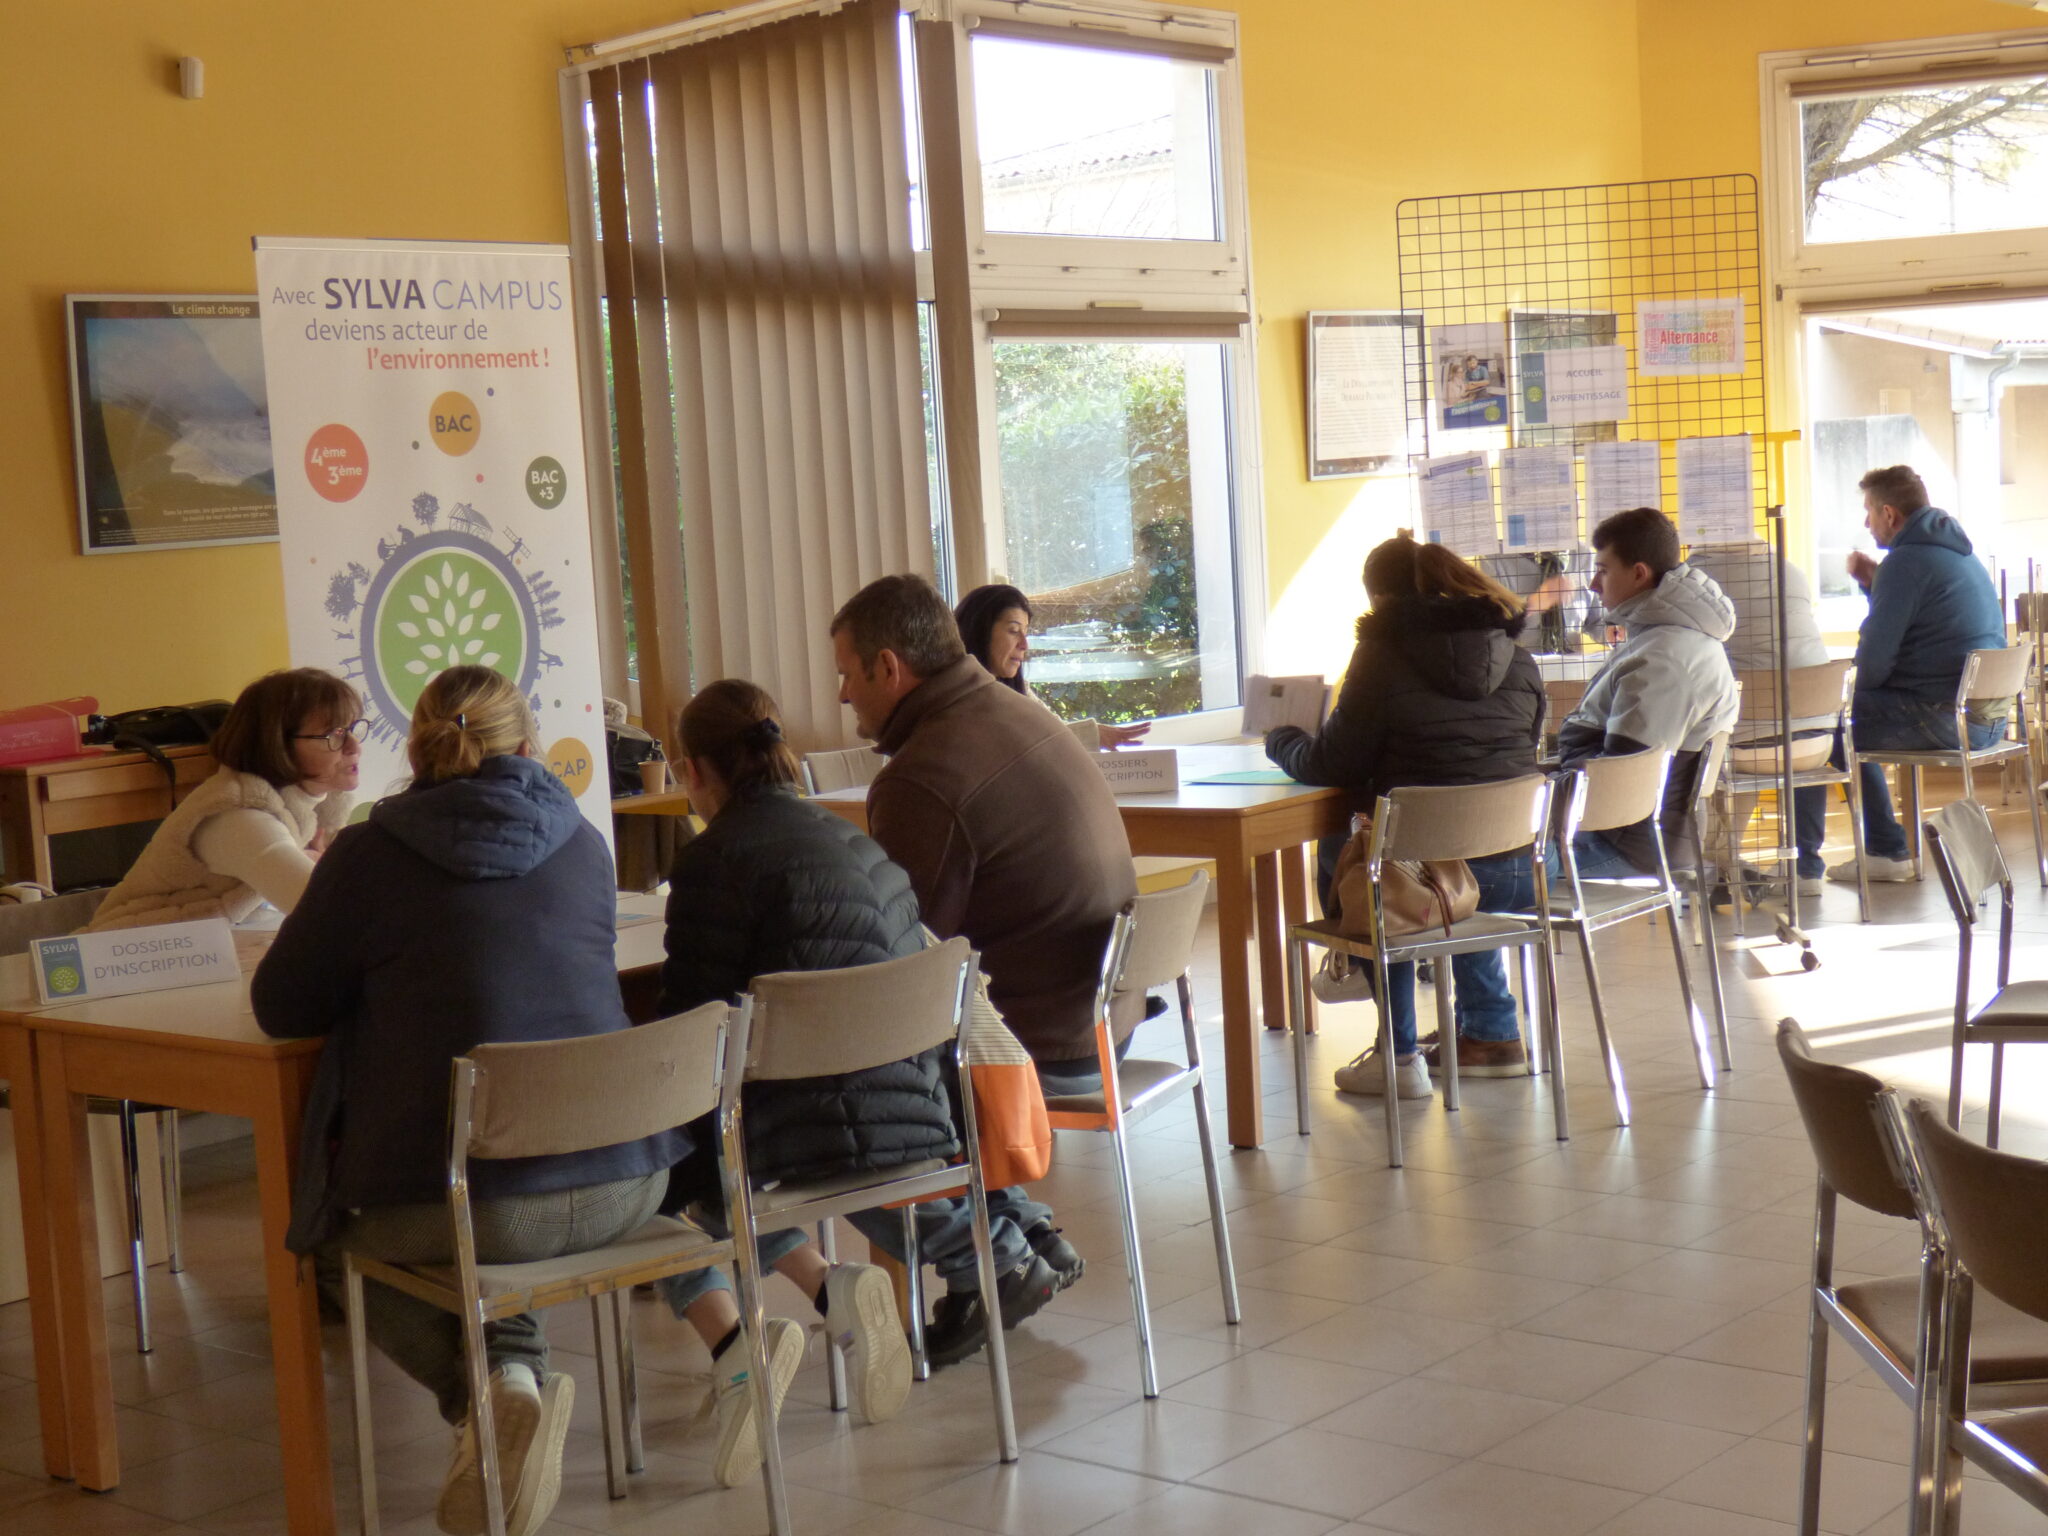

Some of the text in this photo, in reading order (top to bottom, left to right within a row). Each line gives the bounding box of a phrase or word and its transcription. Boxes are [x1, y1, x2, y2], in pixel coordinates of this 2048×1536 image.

[272, 277, 562, 311] Avec SYLVA CAMPUS
[172, 303, 184, 315] Le
[186, 303, 216, 315] climat
[305, 317, 488, 341] deviens acteur de
[1660, 330, 1719, 345] Alternance
[1522, 370, 1545, 379] SYLVA
[1566, 368, 1604, 379] ACCUEIL
[1550, 390, 1622, 403] APPRENTISSAGE
[435, 414, 473, 433] BAC
[311, 447, 347, 467] 4ème
[328, 464, 363, 485] 3ème
[531, 469, 560, 485] BAC
[539, 486, 555, 500] +3
[551, 758, 587, 778] CAP
[42, 943, 78, 955] SYLVA
[112, 936, 194, 957] DOSSIERS
[94, 952, 218, 979] D'INSCRIPTION
